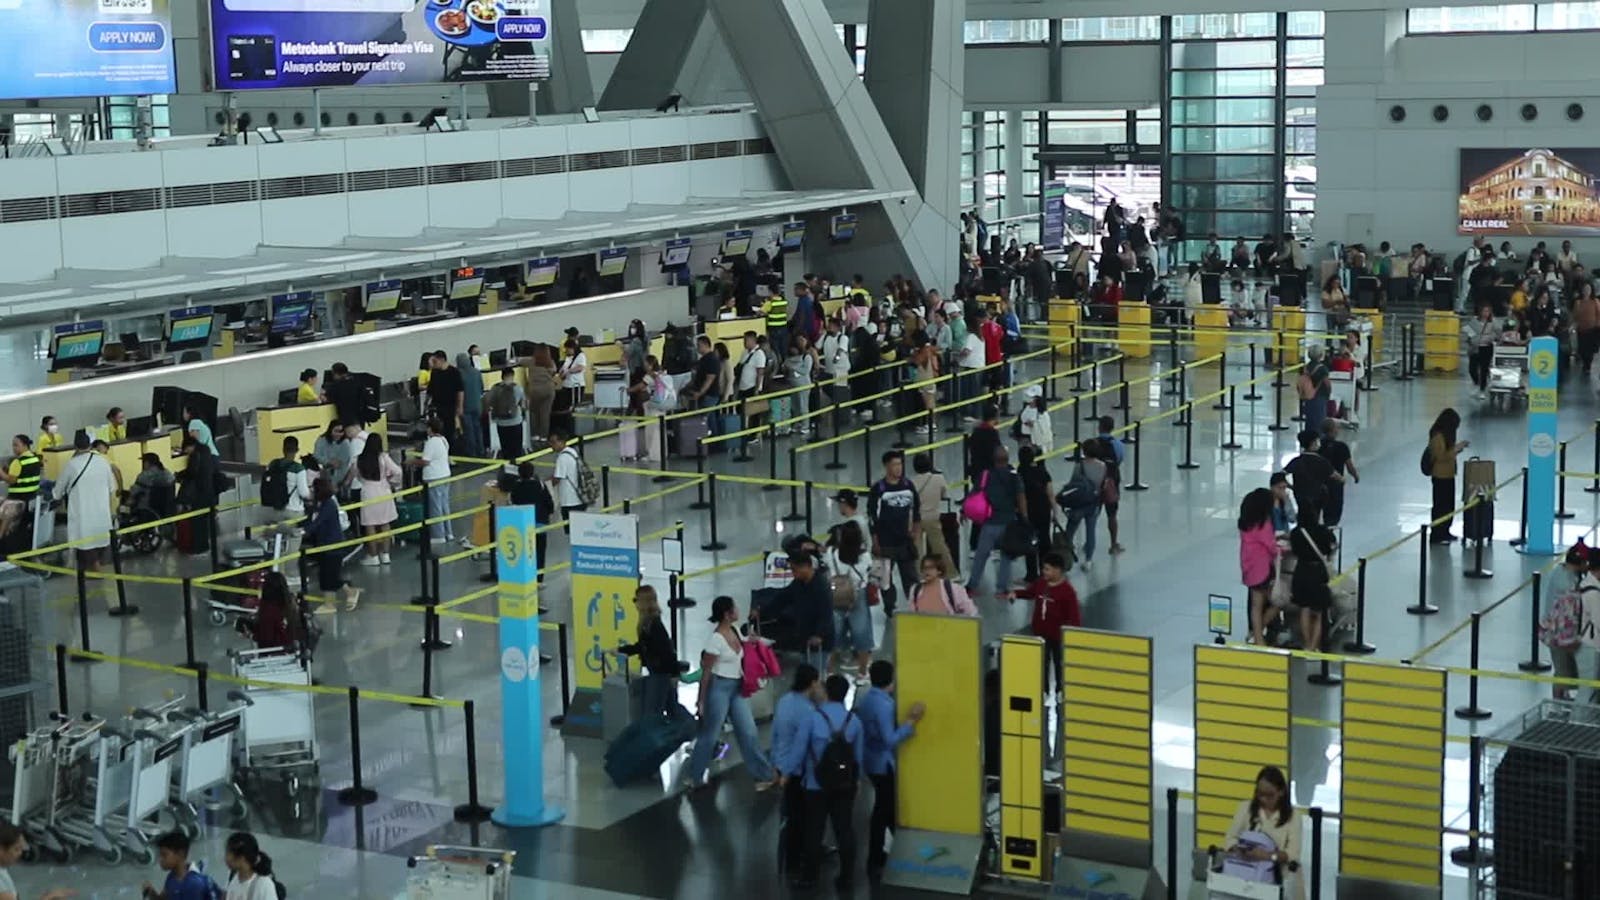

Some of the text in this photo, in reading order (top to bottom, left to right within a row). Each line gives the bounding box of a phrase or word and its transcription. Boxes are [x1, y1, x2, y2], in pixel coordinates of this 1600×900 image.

[502, 24, 522, 33] APPLY
[99, 31, 156, 43] APPLY NOW!
[281, 41, 336, 55] Metrobank
[337, 41, 367, 55] Travel
[368, 41, 413, 57] Signature
[414, 41, 434, 54] Visa
[282, 60, 406, 75] Always closer to your next trip
[1463, 219, 1509, 229] CALLE REAL
[1539, 360, 1549, 375] 2
[507, 541, 517, 561] 3
[614, 554, 630, 562] with
[575, 561, 633, 574] Reduced Mobility
